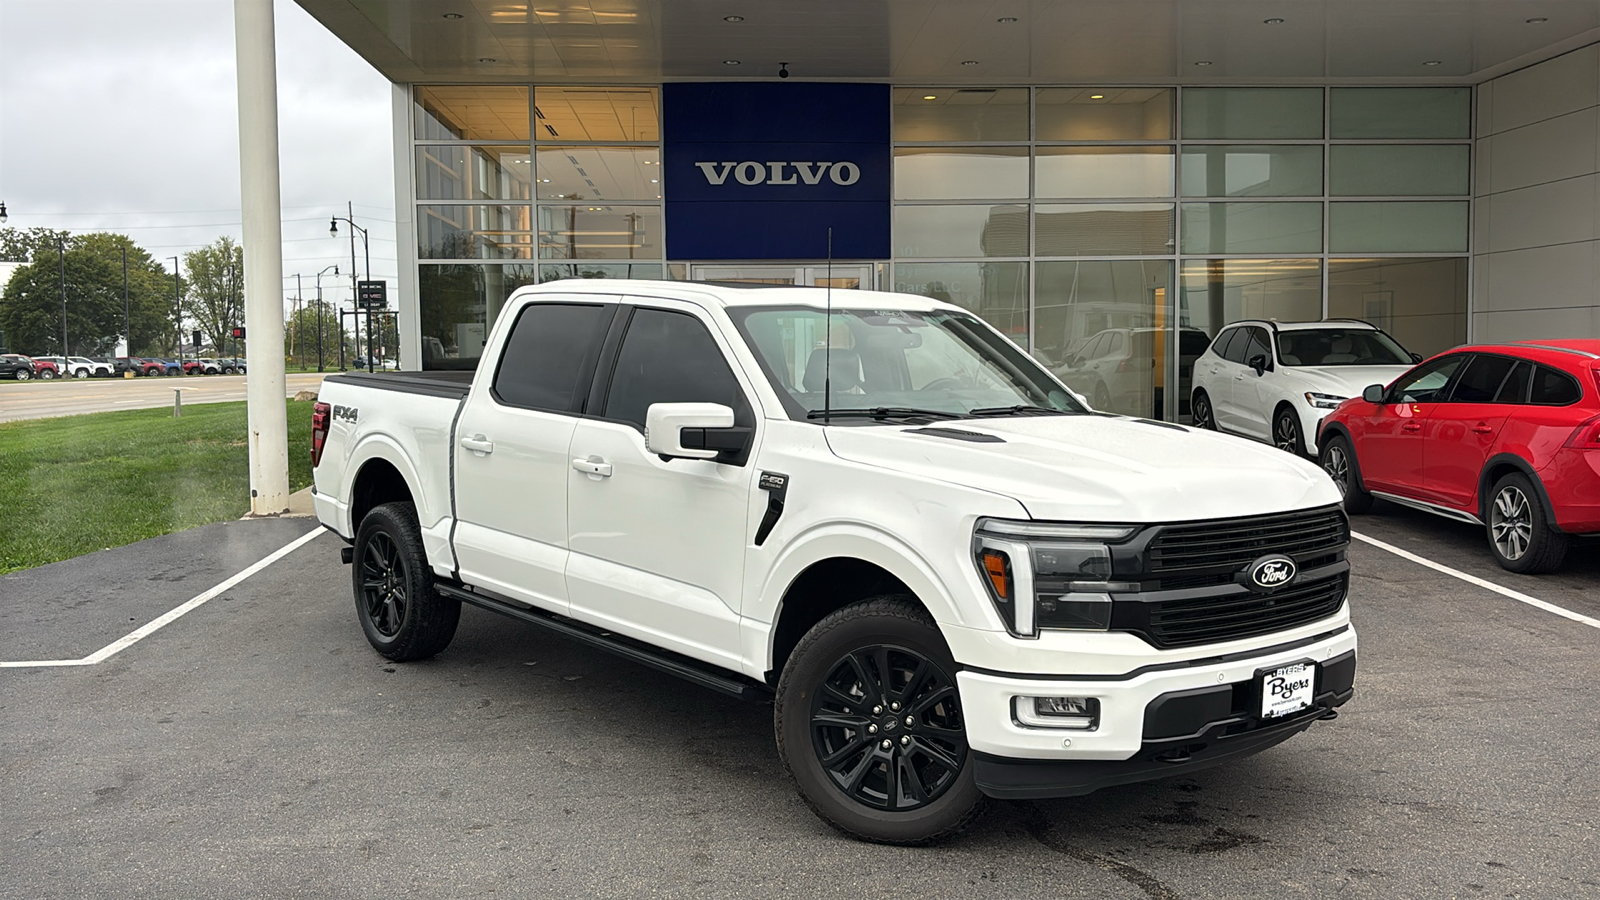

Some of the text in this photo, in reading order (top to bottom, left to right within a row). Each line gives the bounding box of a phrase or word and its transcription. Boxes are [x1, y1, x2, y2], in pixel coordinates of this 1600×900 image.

[694, 161, 861, 186] VOLVO
[896, 281, 929, 293] Cars
[333, 405, 358, 421] FX4
[1261, 563, 1288, 583] Ford
[1266, 676, 1310, 700] Byers
